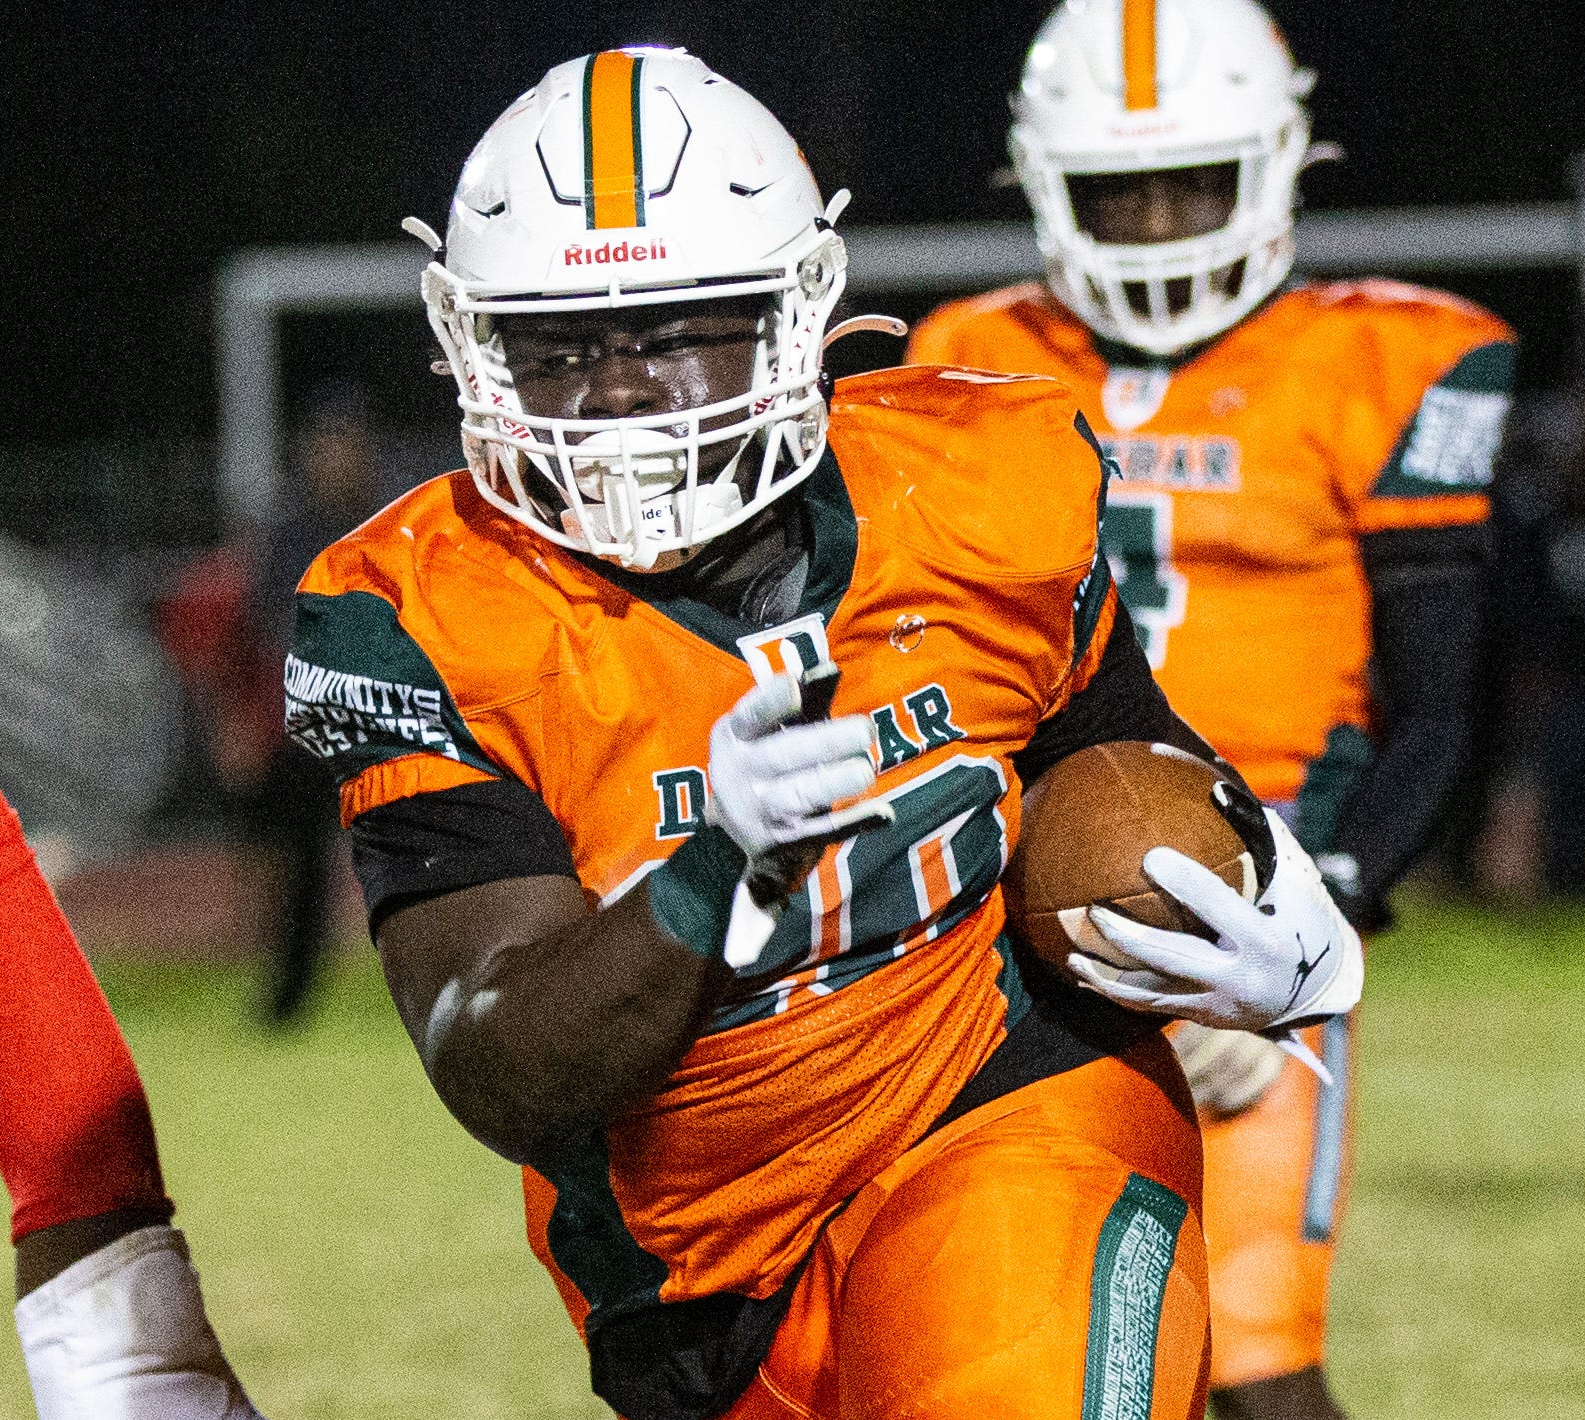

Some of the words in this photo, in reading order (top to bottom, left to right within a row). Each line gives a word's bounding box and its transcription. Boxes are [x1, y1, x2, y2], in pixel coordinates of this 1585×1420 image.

[564, 237, 667, 267] Riddell
[284, 652, 414, 717] COMMUNITY
[653, 683, 967, 841] DAR
